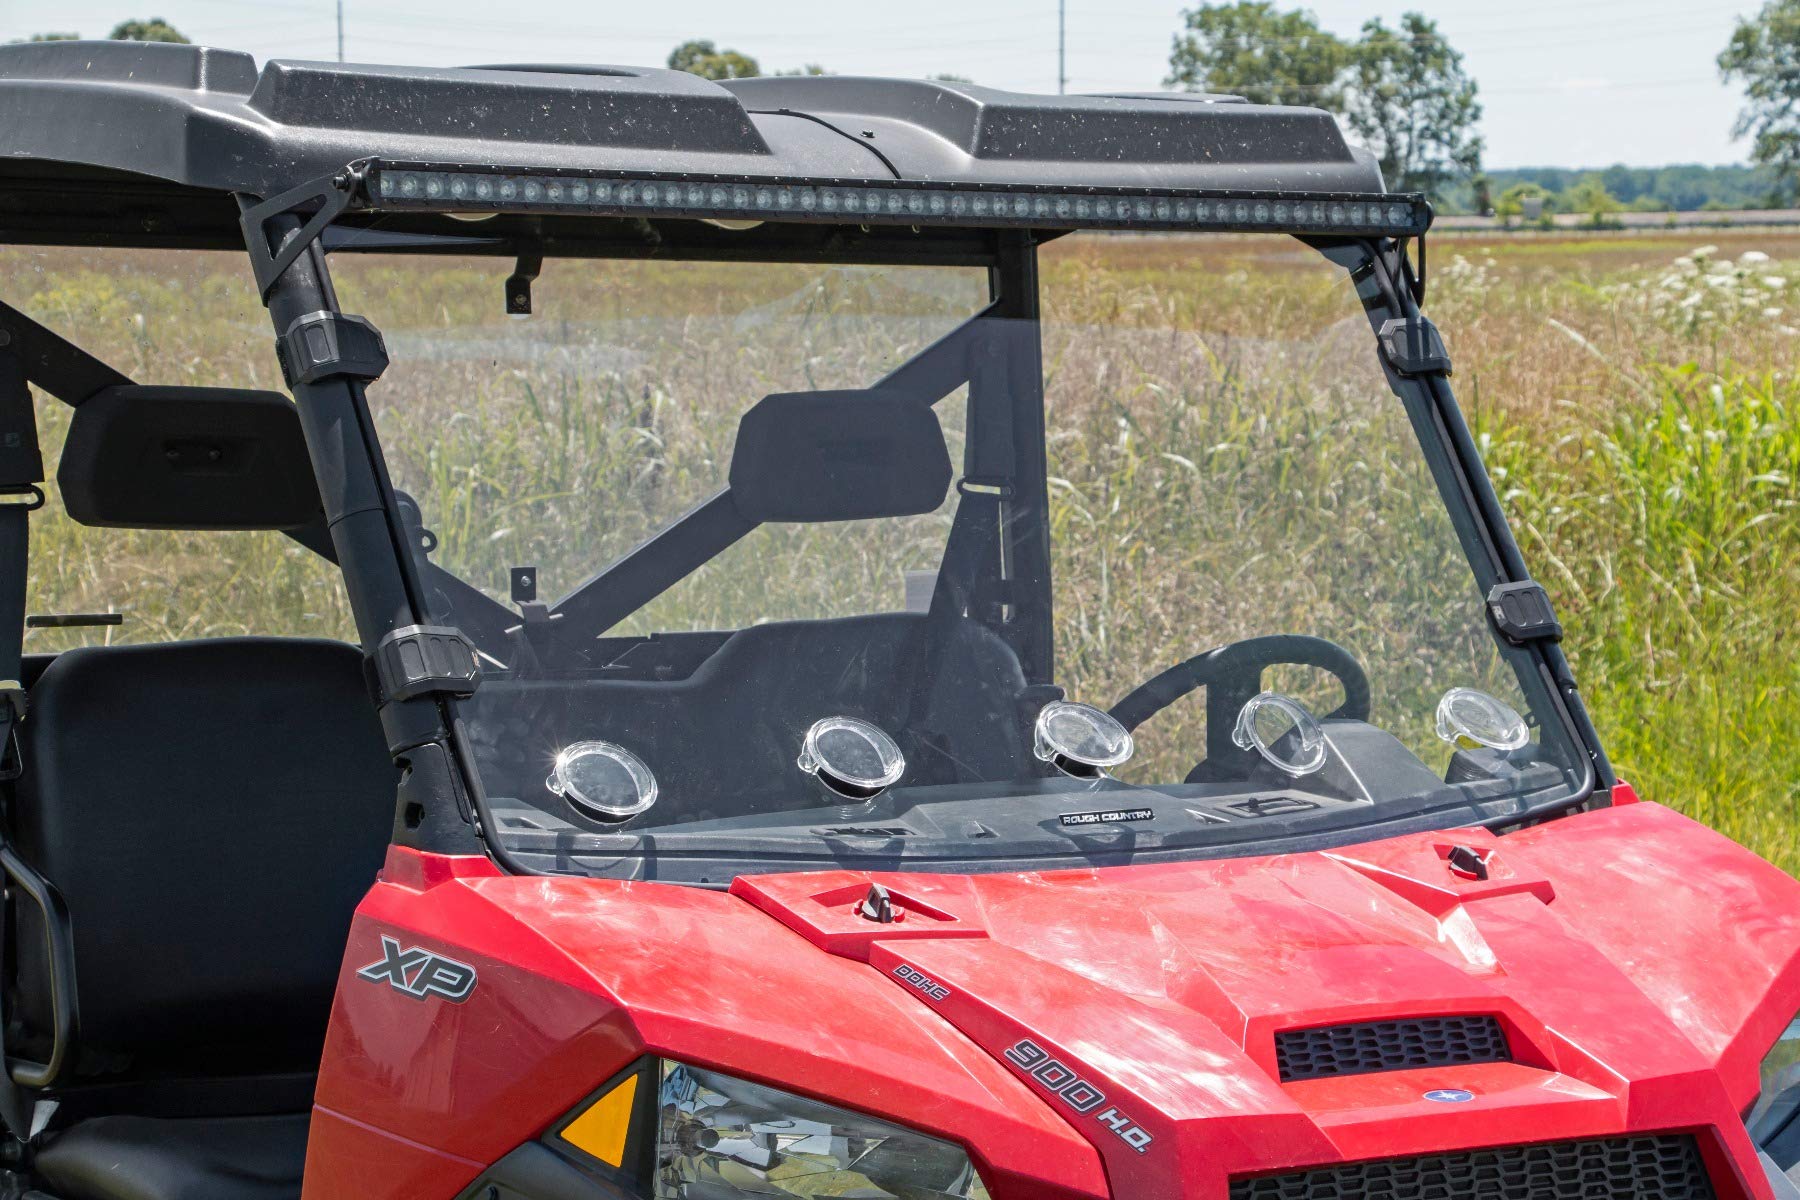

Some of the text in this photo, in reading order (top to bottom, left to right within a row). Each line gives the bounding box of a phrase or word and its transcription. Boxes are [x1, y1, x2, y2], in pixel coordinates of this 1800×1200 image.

[1063, 810, 1152, 825] ROUGH COUNTRY
[356, 934, 478, 1004] XP
[892, 964, 951, 1001] DOHC
[1004, 1038, 1106, 1113] 900
